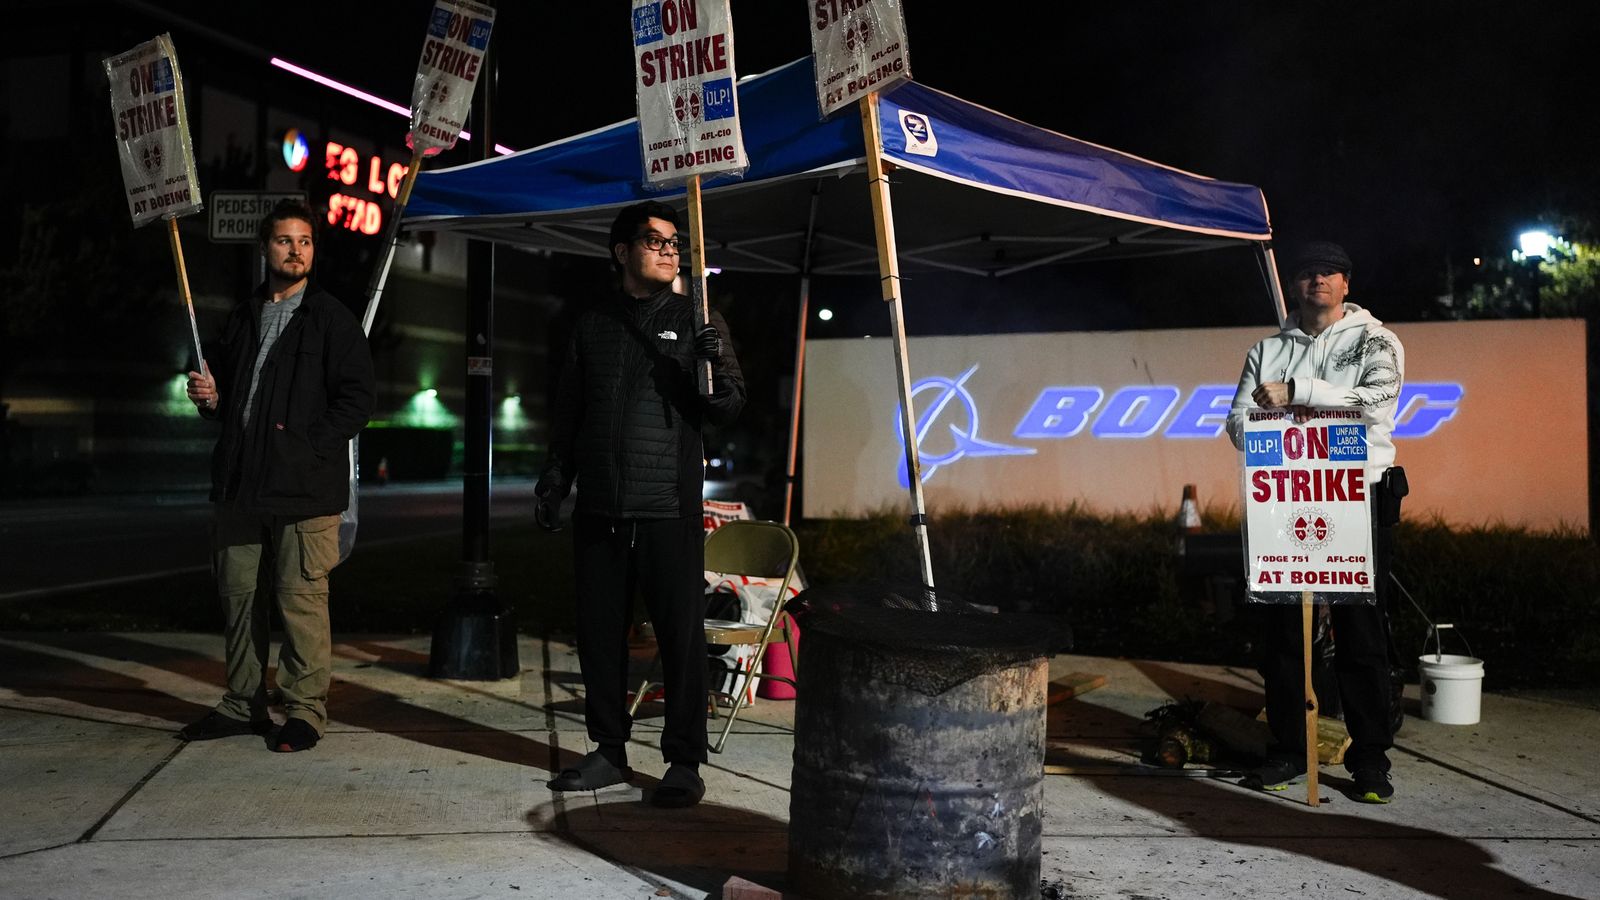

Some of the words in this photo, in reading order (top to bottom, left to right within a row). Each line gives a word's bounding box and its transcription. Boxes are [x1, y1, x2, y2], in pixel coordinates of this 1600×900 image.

[448, 13, 472, 43] ON
[662, 0, 697, 36] ON
[422, 39, 480, 82] STRIKE
[640, 33, 727, 87] STRIKE
[871, 42, 900, 62] AFL-CIO
[130, 62, 154, 98] ON
[825, 86, 844, 107] AT
[847, 57, 904, 95] BOEING
[706, 88, 731, 107] ULP!
[118, 95, 177, 142] STRIKE
[648, 139, 673, 152] LODGE
[701, 128, 732, 142] AFL-CIO
[651, 157, 670, 174] AT
[674, 145, 735, 170] BOEING
[133, 200, 149, 216] AT
[150, 188, 191, 211] BOEING
[1012, 384, 1465, 438] BOEG
[1312, 410, 1362, 419] ACHINISTS
[1283, 426, 1329, 460] ON
[1335, 427, 1359, 436] UNFAIR
[1336, 436, 1358, 445] LABOR
[1248, 439, 1279, 454] ULP!
[1330, 446, 1367, 455] PRACTICES!
[1251, 468, 1366, 503] STRIKE
[1292, 555, 1310, 563] 751
[1326, 555, 1366, 563] AFL-CIO
[1258, 570, 1285, 584] AT
[1290, 570, 1369, 585] BOEING
